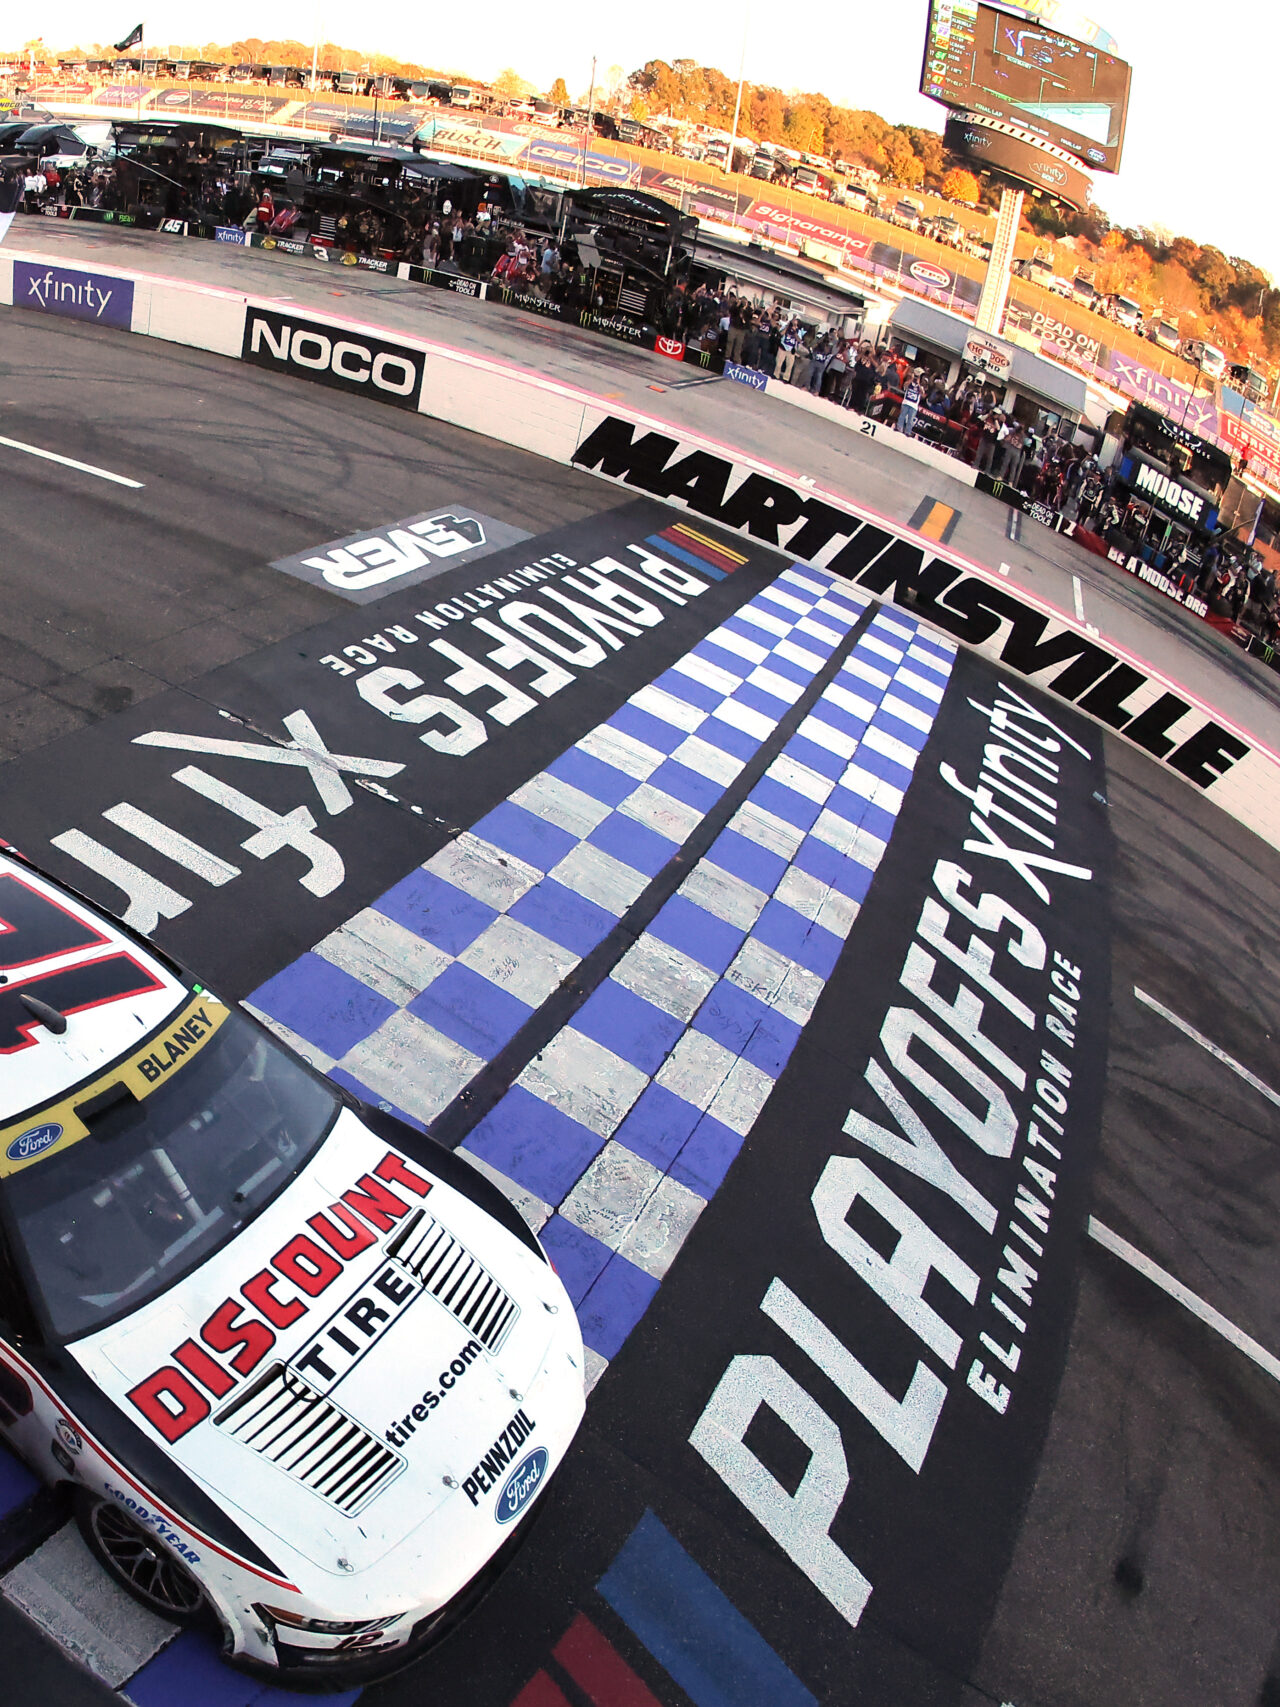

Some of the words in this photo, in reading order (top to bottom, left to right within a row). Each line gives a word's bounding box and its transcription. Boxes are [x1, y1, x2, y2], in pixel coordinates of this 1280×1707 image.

[434, 129, 503, 151] BUSCH
[963, 132, 992, 147] xfinity
[531, 145, 629, 177] GEICO
[164, 220, 183, 232] 45
[217, 230, 244, 245] xfinity
[277, 240, 305, 251] TRACKER
[313, 245, 329, 262] 3
[358, 257, 388, 268] TRACKER
[27, 271, 113, 318] xfinity
[455, 286, 475, 296] TOOLS
[913, 265, 949, 285] PEPSI
[514, 292, 561, 313] MONSTER
[592, 315, 642, 338] MONSTER
[1030, 326, 1097, 363] TOOLS
[1032, 311, 1074, 339] DEAD
[1077, 332, 1099, 353] ON
[250, 318, 417, 397] NOCO
[727, 366, 764, 389] xfinity
[973, 355, 1001, 372] SND
[1115, 359, 1214, 432] xfinity
[860, 421, 877, 437] 21
[1031, 502, 1046, 515] DEAD
[1045, 511, 1054, 519] ON
[1136, 462, 1204, 521] MOOSE
[1029, 510, 1052, 527] TOOLS
[1063, 520, 1077, 537] 1
[415, 552, 576, 632] ELIMINATION
[1107, 545, 1125, 567] BE
[1125, 556, 1137, 574] A
[1138, 562, 1209, 618] MOOSE.ORG
[575, 419, 1252, 790] MARTINSVILLE
[319, 623, 420, 677] RACE
[356, 542, 713, 758] PLAYOFFS
[937, 681, 1094, 906] xfinity
[50, 708, 407, 936] xfin
[136, 1007, 213, 1083] BLANEY
[19, 1127, 52, 1158] Ford
[966, 1049, 1077, 1415] ELIMINATION
[1043, 949, 1082, 1049] RACE
[687, 857, 1048, 1629] PLAYOFFS
[125, 1150, 435, 1445] DISCOUNT
[296, 1266, 417, 1384] TIRE
[384, 1339, 484, 1449] tires.com
[461, 1407, 538, 1507] PENNZOIL
[503, 1461, 542, 1512] Ford
[103, 1481, 202, 1567] GOODYEAR
